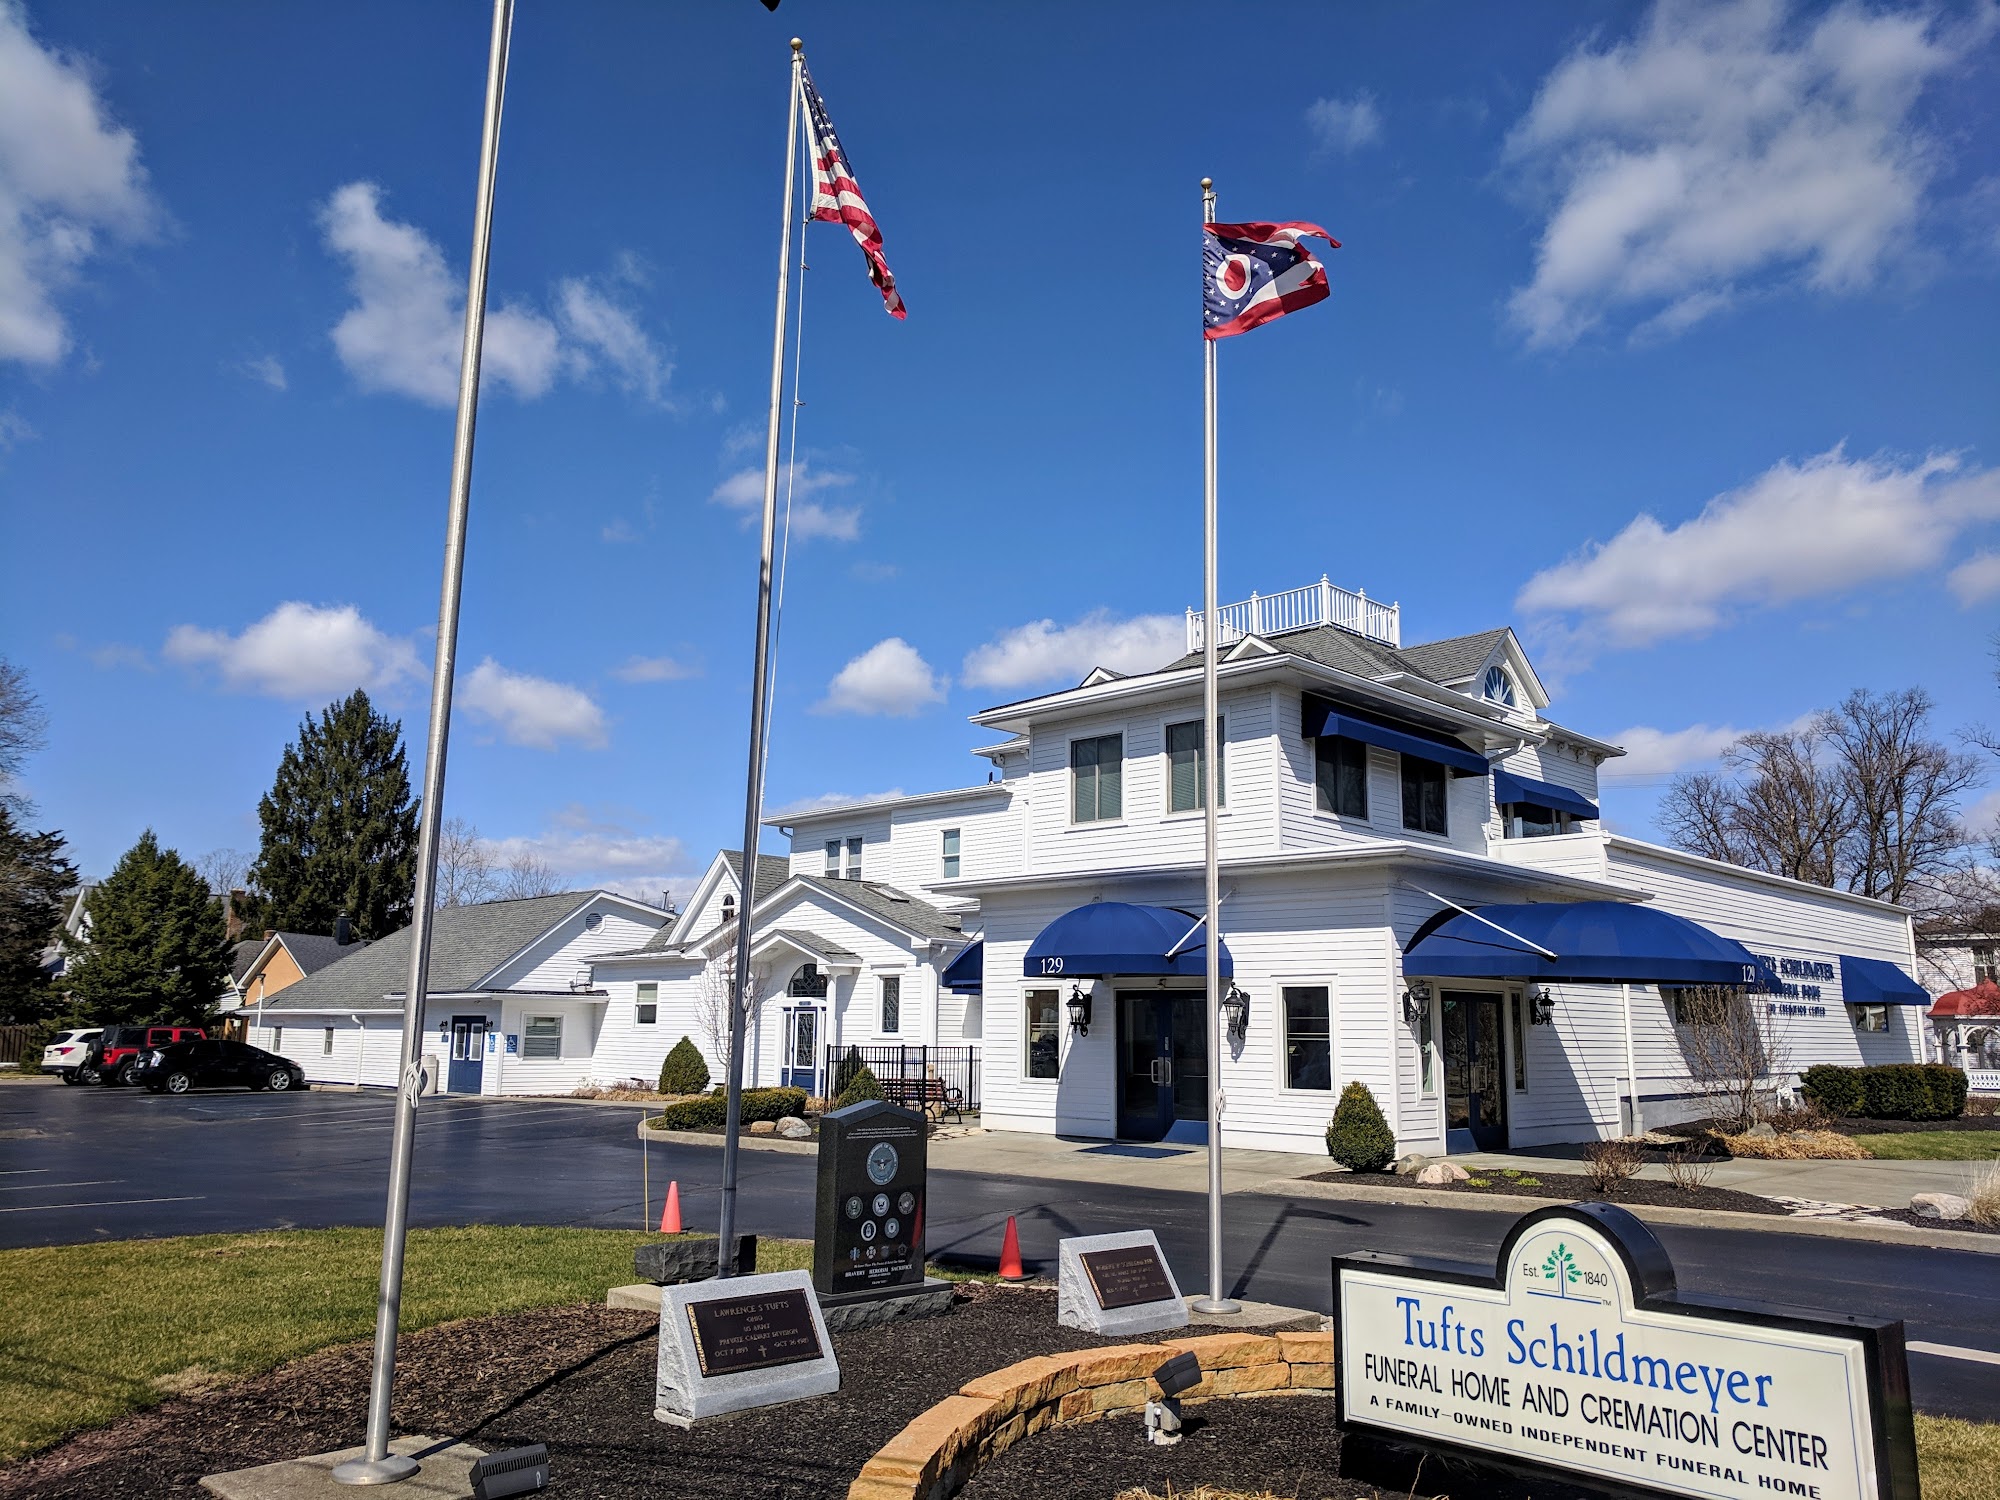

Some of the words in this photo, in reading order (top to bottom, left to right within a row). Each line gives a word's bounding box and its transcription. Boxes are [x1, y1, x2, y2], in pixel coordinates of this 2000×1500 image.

[1040, 957, 1064, 974] 129
[1523, 1263, 1540, 1277] Est.
[1583, 1272, 1608, 1287] 1840
[714, 1304, 757, 1318] LAWRENCE
[758, 1303, 763, 1312] S
[764, 1301, 790, 1311] TUFTS
[746, 1314, 763, 1323] OHIO
[753, 1323, 770, 1331] ARMY
[719, 1336, 744, 1346] PRIVATE
[771, 1328, 799, 1338] DIVISION
[1396, 1296, 1485, 1357] Tufts
[1507, 1319, 1773, 1414] Schildmeyer
[1365, 1353, 1443, 1394] FUNERAL
[1452, 1368, 1511, 1407] HOME
[1522, 1382, 1570, 1418] AND
[1580, 1392, 1720, 1449] CREMATION
[1731, 1420, 1830, 1471] CENTER
[1370, 1395, 1379, 1406] A
[1521, 1425, 1648, 1462] INDEPENDENT
[1656, 1453, 1750, 1485] FUNERAL
[1757, 1474, 1822, 1500] HOME
